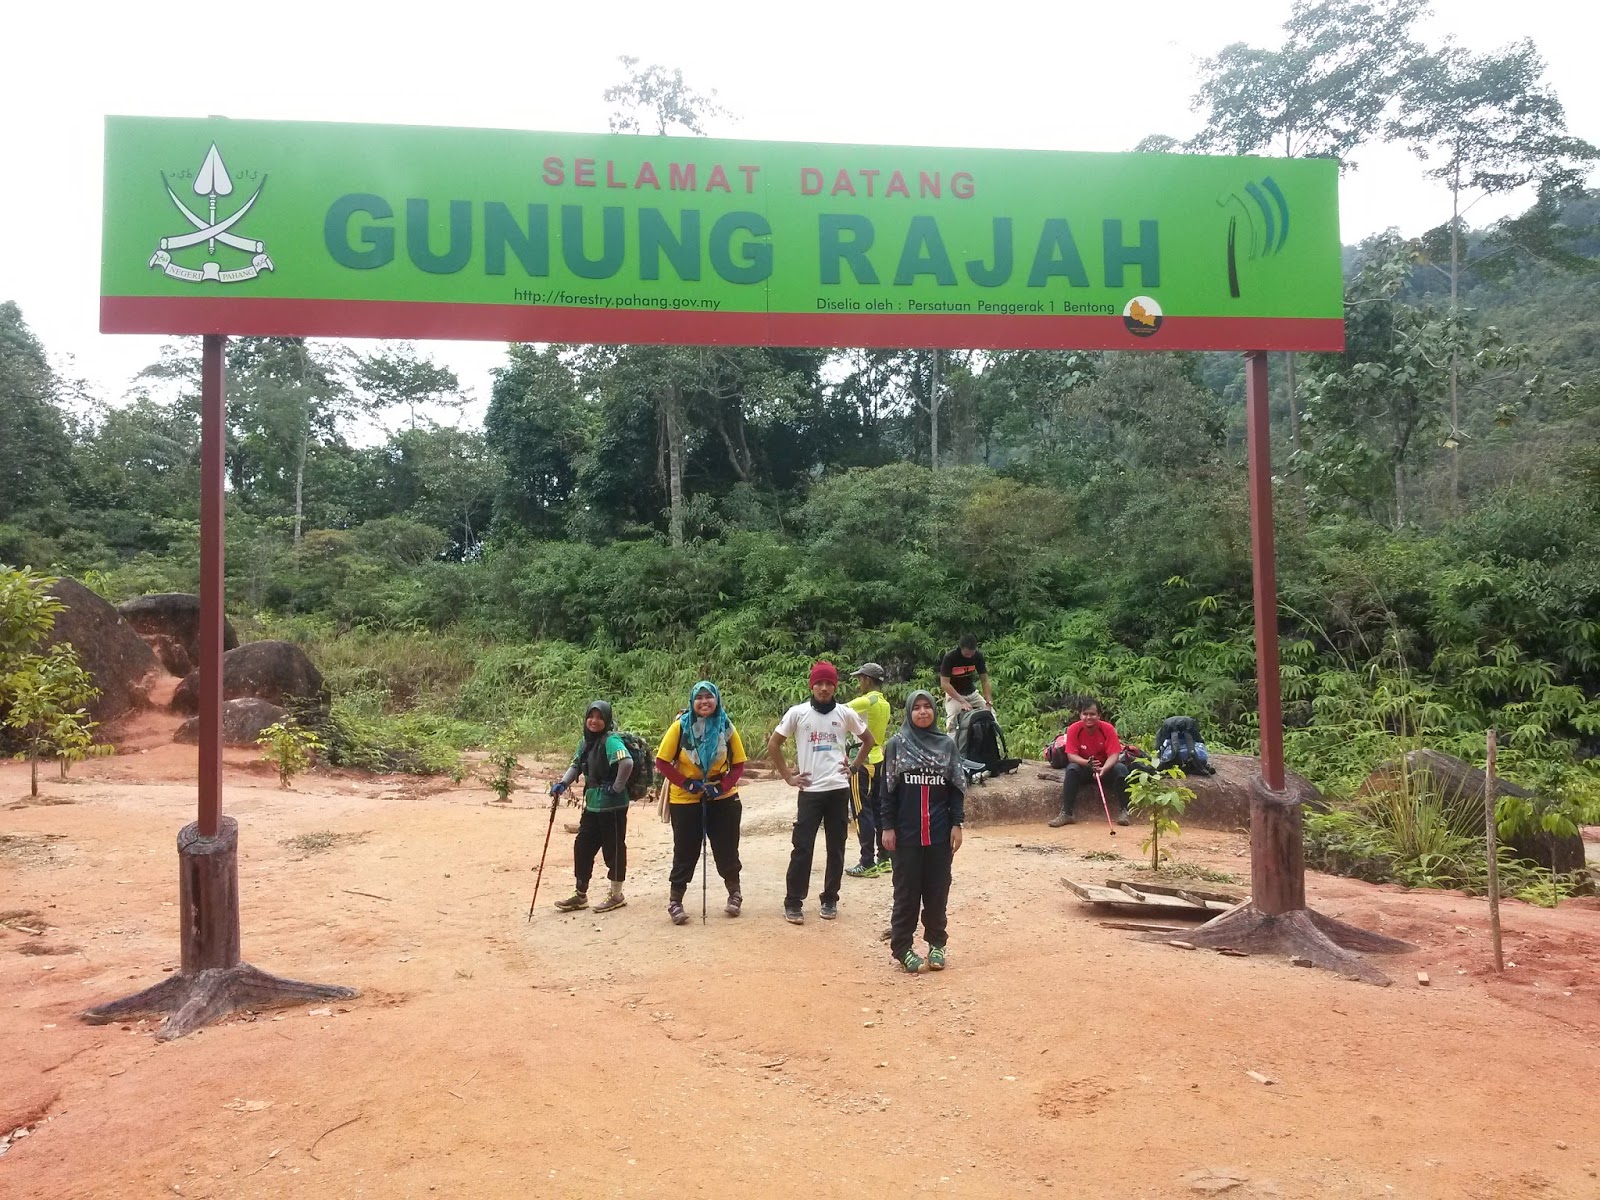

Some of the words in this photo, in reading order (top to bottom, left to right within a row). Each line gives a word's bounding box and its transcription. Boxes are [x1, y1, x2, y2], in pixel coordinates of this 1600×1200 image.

[541, 156, 760, 193] SELAMAT
[801, 167, 975, 199] DATANG
[324, 193, 773, 285] GUNUNG
[818, 213, 1160, 287] RAJAH
[168, 265, 202, 280] NEGERI
[222, 268, 255, 280] PAHANG
[513, 288, 721, 311] http://forestry.pahang.gov.my
[816, 298, 860, 310] Diselia
[865, 299, 893, 310] oleh
[908, 299, 971, 311] Persatuan
[977, 300, 1044, 314] Penggerak
[1064, 301, 1115, 315] Bentong
